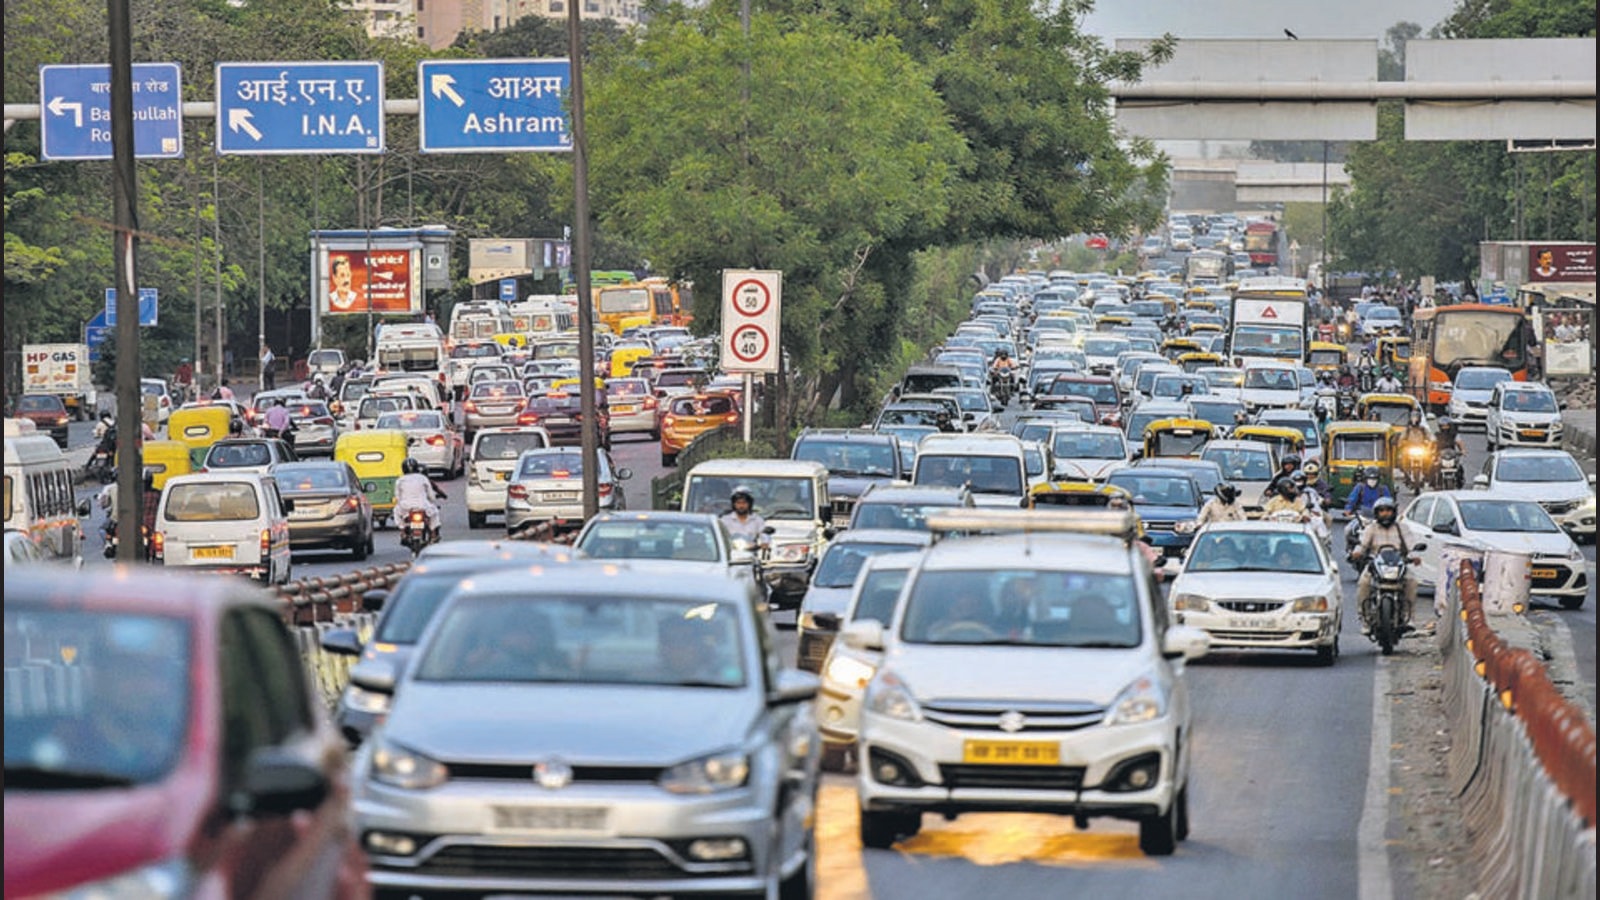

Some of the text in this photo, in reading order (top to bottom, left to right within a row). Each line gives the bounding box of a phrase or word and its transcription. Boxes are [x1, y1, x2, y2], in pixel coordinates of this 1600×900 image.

[237, 71, 372, 106] आई.एन.ए.
[488, 76, 562, 99] आश्रम
[90, 107, 177, 121] Baullah
[302, 114, 372, 136] I.N.A.
[463, 112, 564, 134] Ashram
[91, 129, 111, 142] Ro
[745, 296, 758, 308] 50
[742, 343, 757, 355] 40
[26, 351, 76, 362] HP GAS
